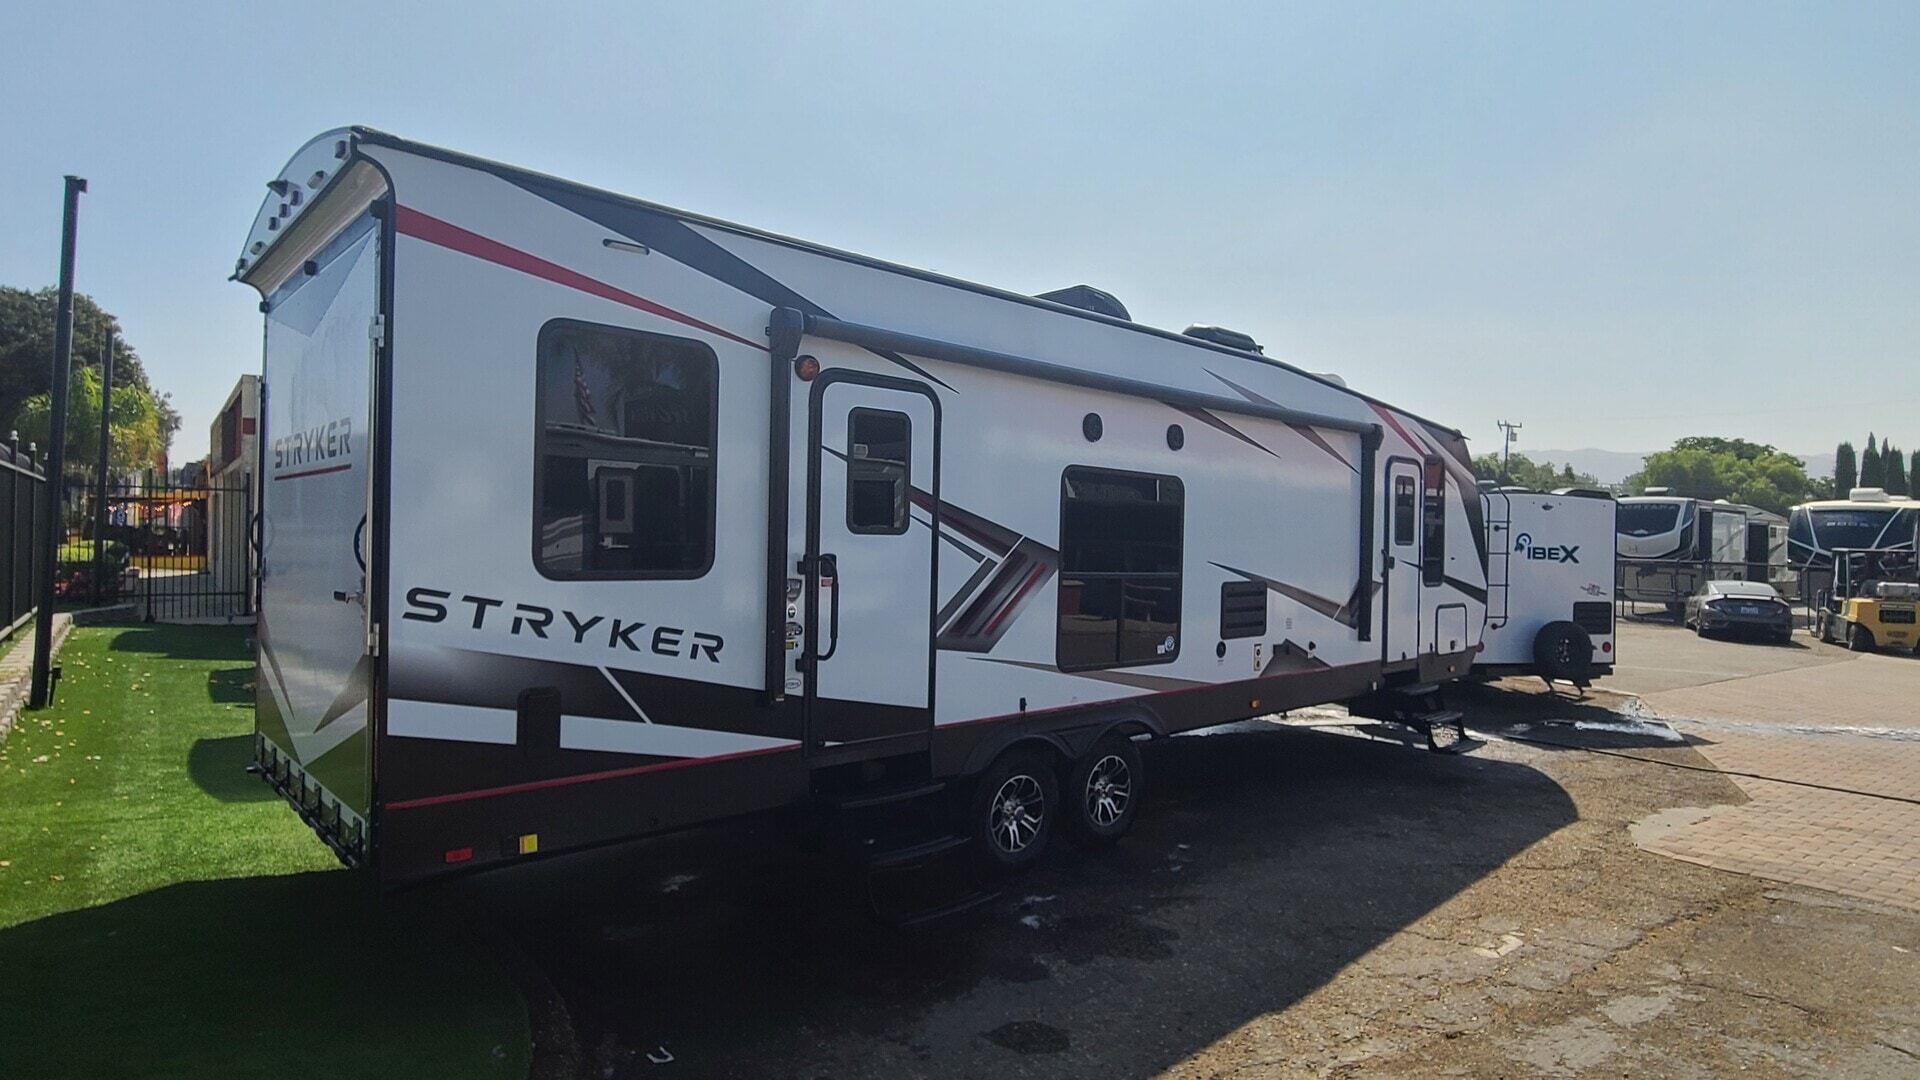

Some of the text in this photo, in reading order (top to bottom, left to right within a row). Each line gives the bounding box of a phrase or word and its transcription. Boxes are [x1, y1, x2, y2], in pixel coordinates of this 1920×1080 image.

[274, 417, 351, 469] STRYKER
[1527, 545, 1580, 563] IBEX
[402, 587, 724, 663] STRYKER
